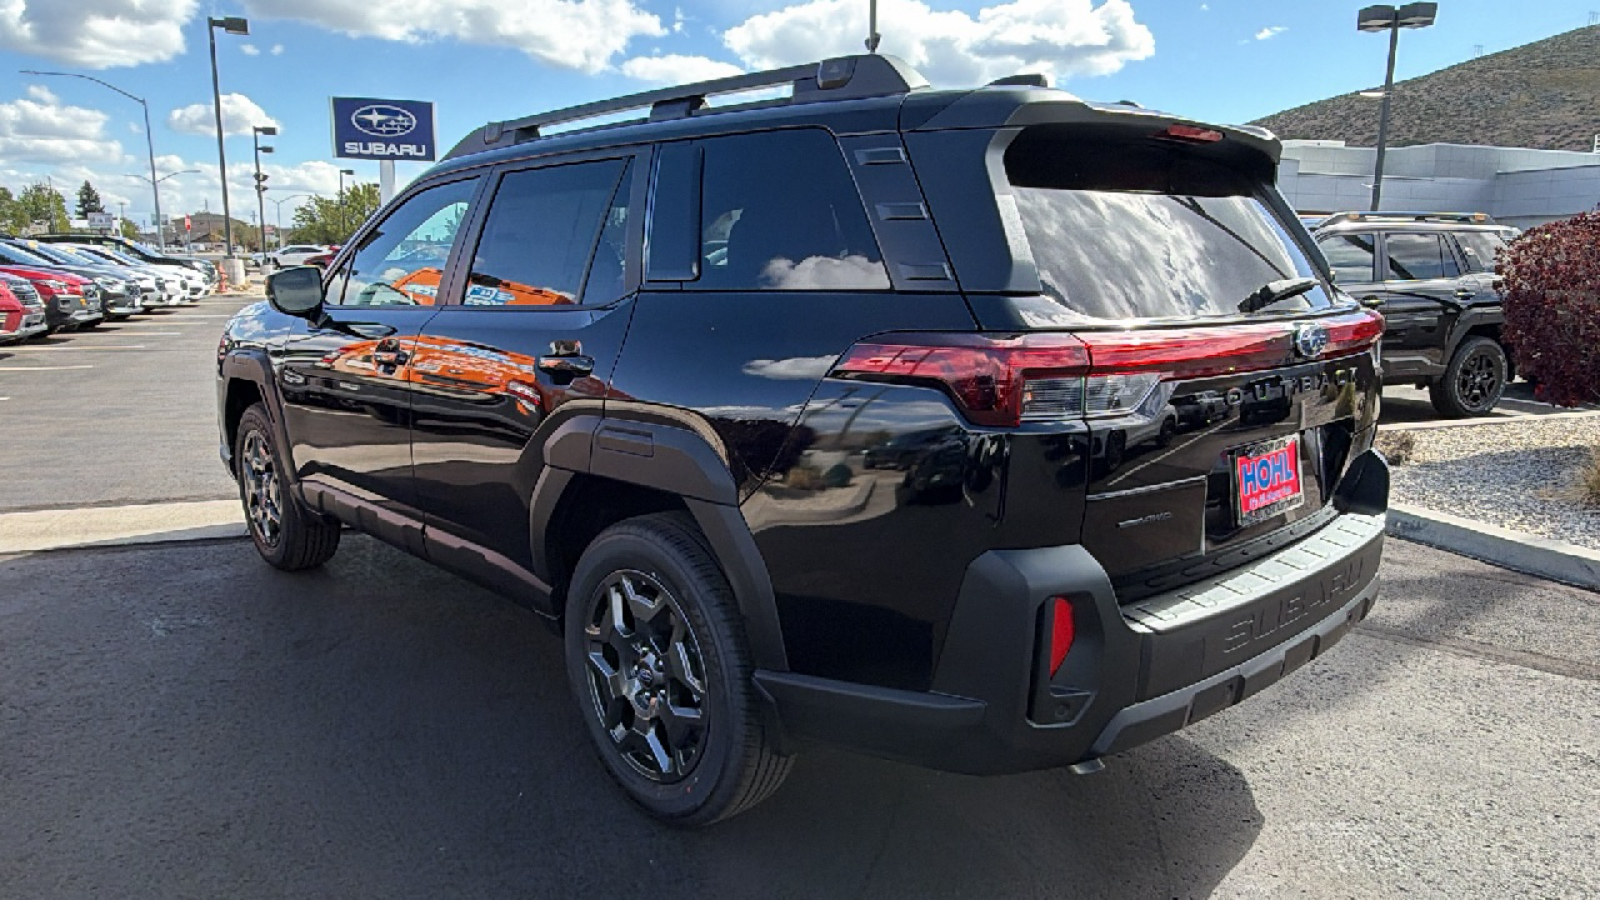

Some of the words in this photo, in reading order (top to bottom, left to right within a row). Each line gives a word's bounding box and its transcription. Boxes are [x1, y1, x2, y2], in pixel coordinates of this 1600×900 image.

[344, 142, 426, 156] SUBARU
[1241, 450, 1293, 496] HOHL
[1223, 556, 1363, 654] SUBARU
